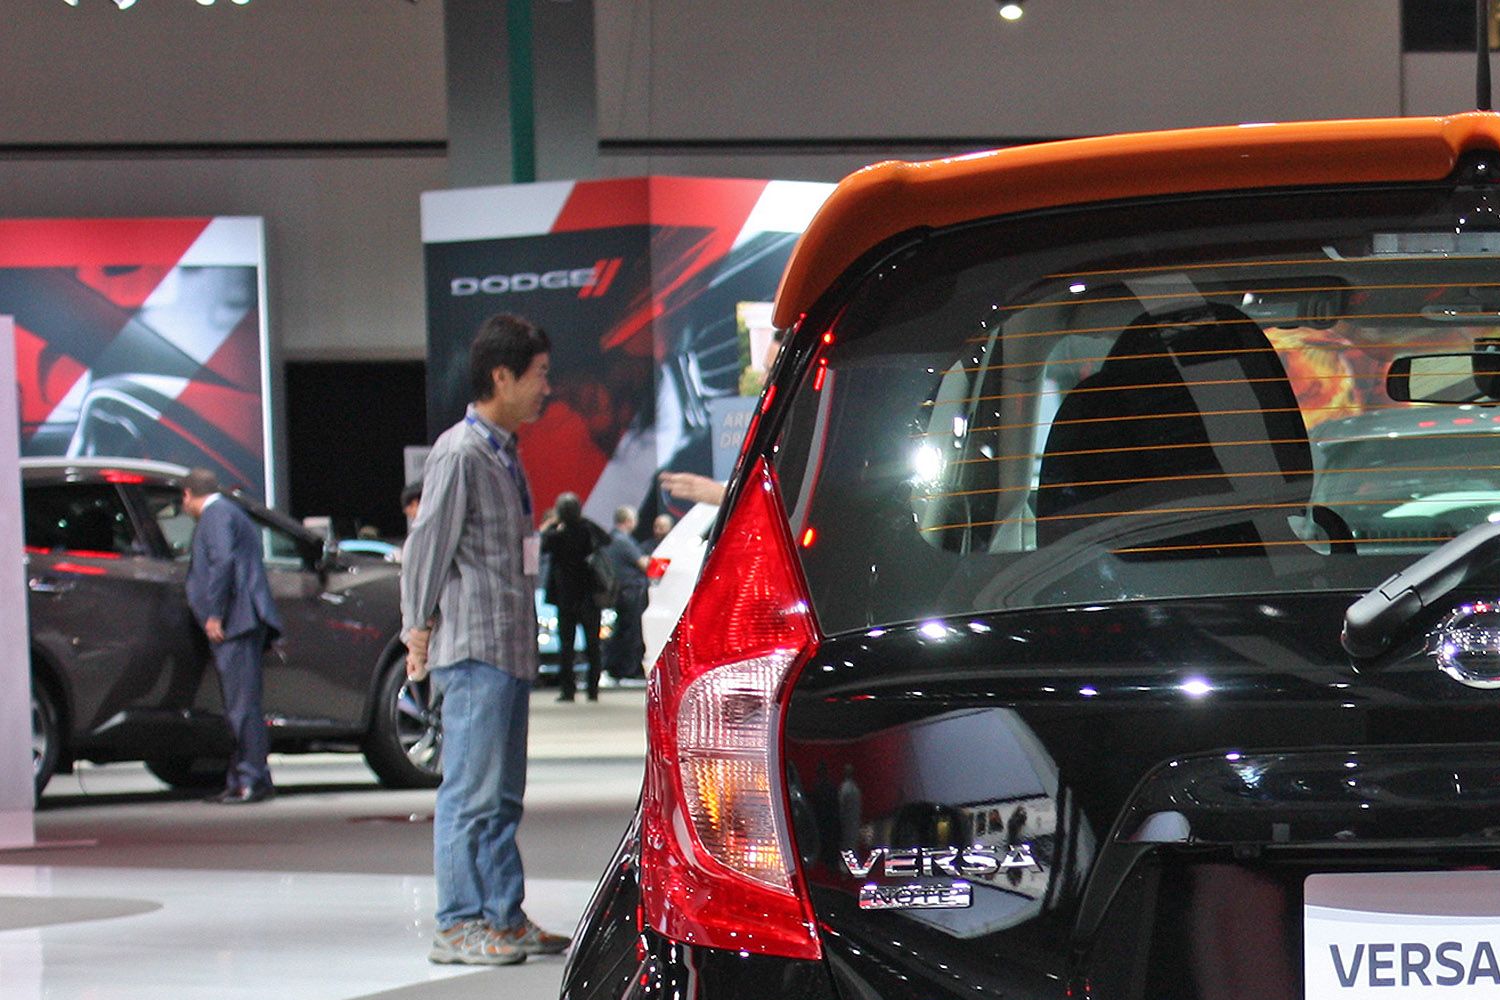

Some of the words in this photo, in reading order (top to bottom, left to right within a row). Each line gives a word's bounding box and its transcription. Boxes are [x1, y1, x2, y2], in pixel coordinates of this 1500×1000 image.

[450, 267, 598, 296] DODGE
[839, 844, 1045, 878] VERSA
[865, 883, 972, 907] NOTE
